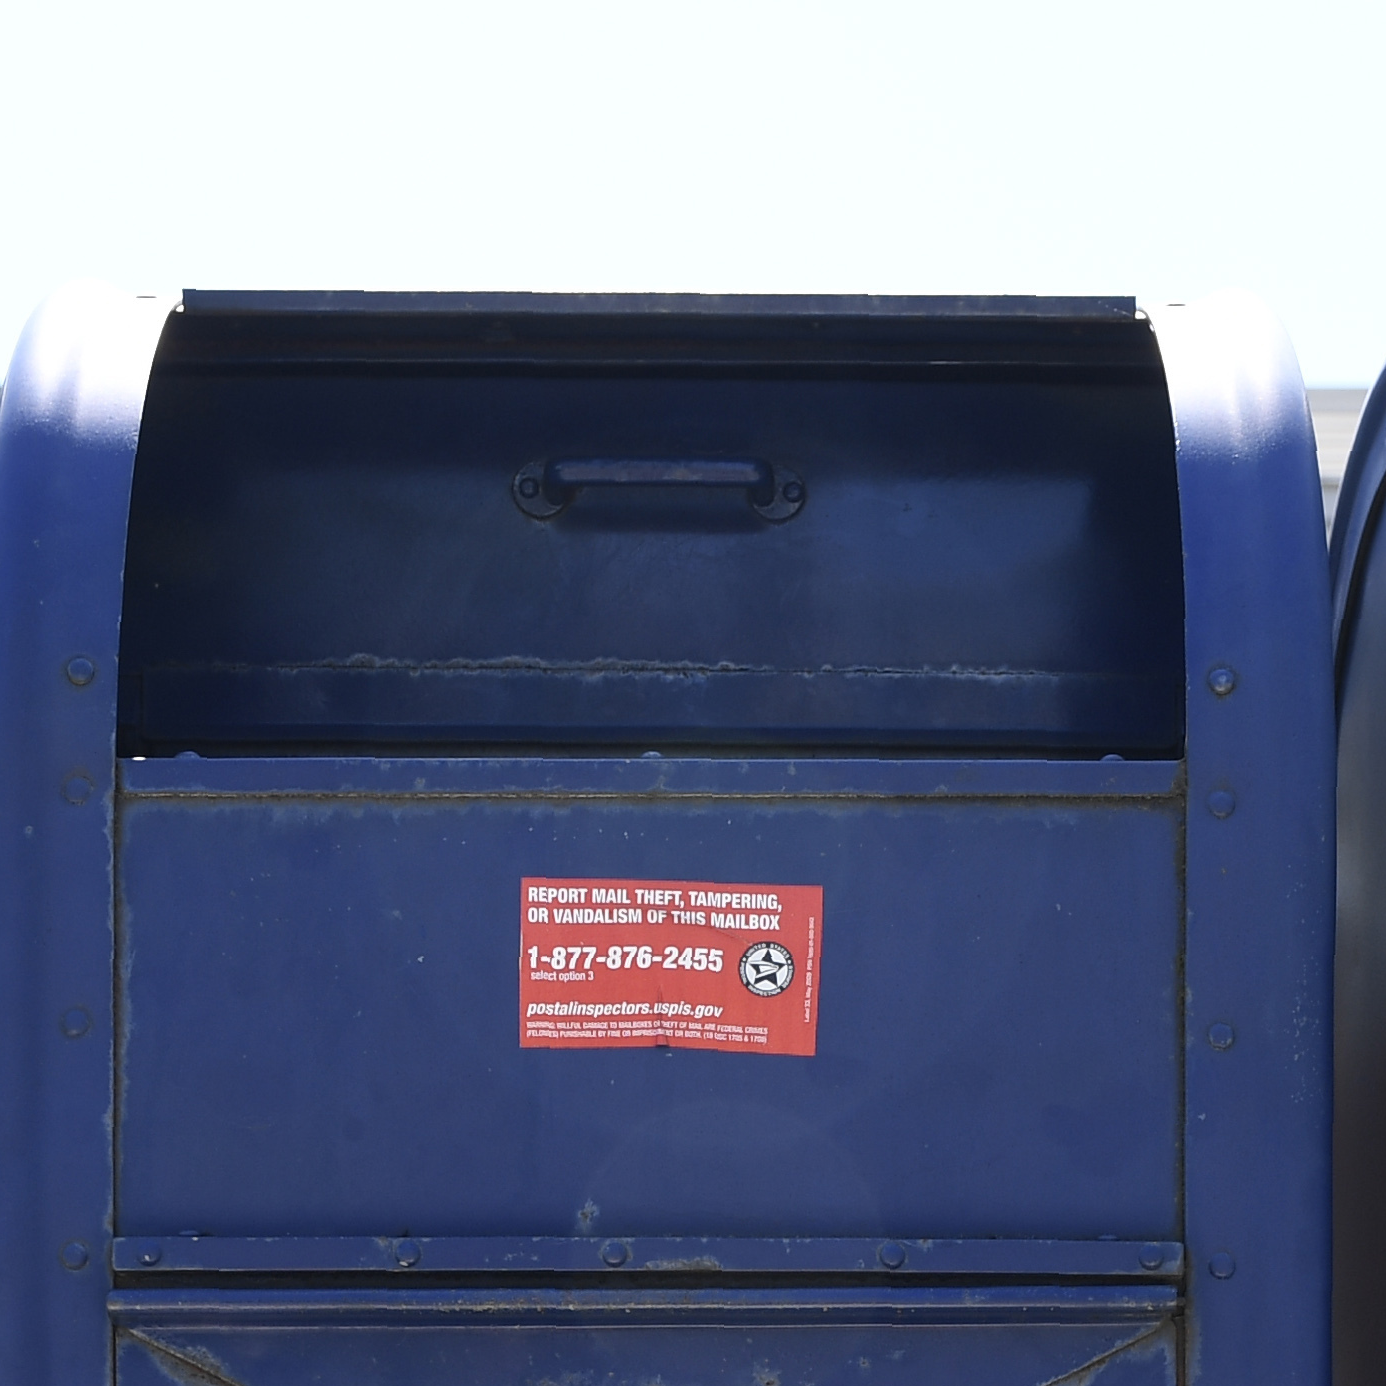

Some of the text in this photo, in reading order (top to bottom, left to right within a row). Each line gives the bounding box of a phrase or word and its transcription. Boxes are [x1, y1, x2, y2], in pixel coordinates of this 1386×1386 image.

[529, 887, 782, 912] REPORT MAIL THEFT, TAMPERING,
[528, 907, 779, 930] OR VANDALISM OF THIS MAILBOX
[528, 946, 723, 974] 1-877-876-2455
[531, 971, 594, 982] select option 3
[527, 1001, 723, 1018] postalinspectors.uspis.gov
